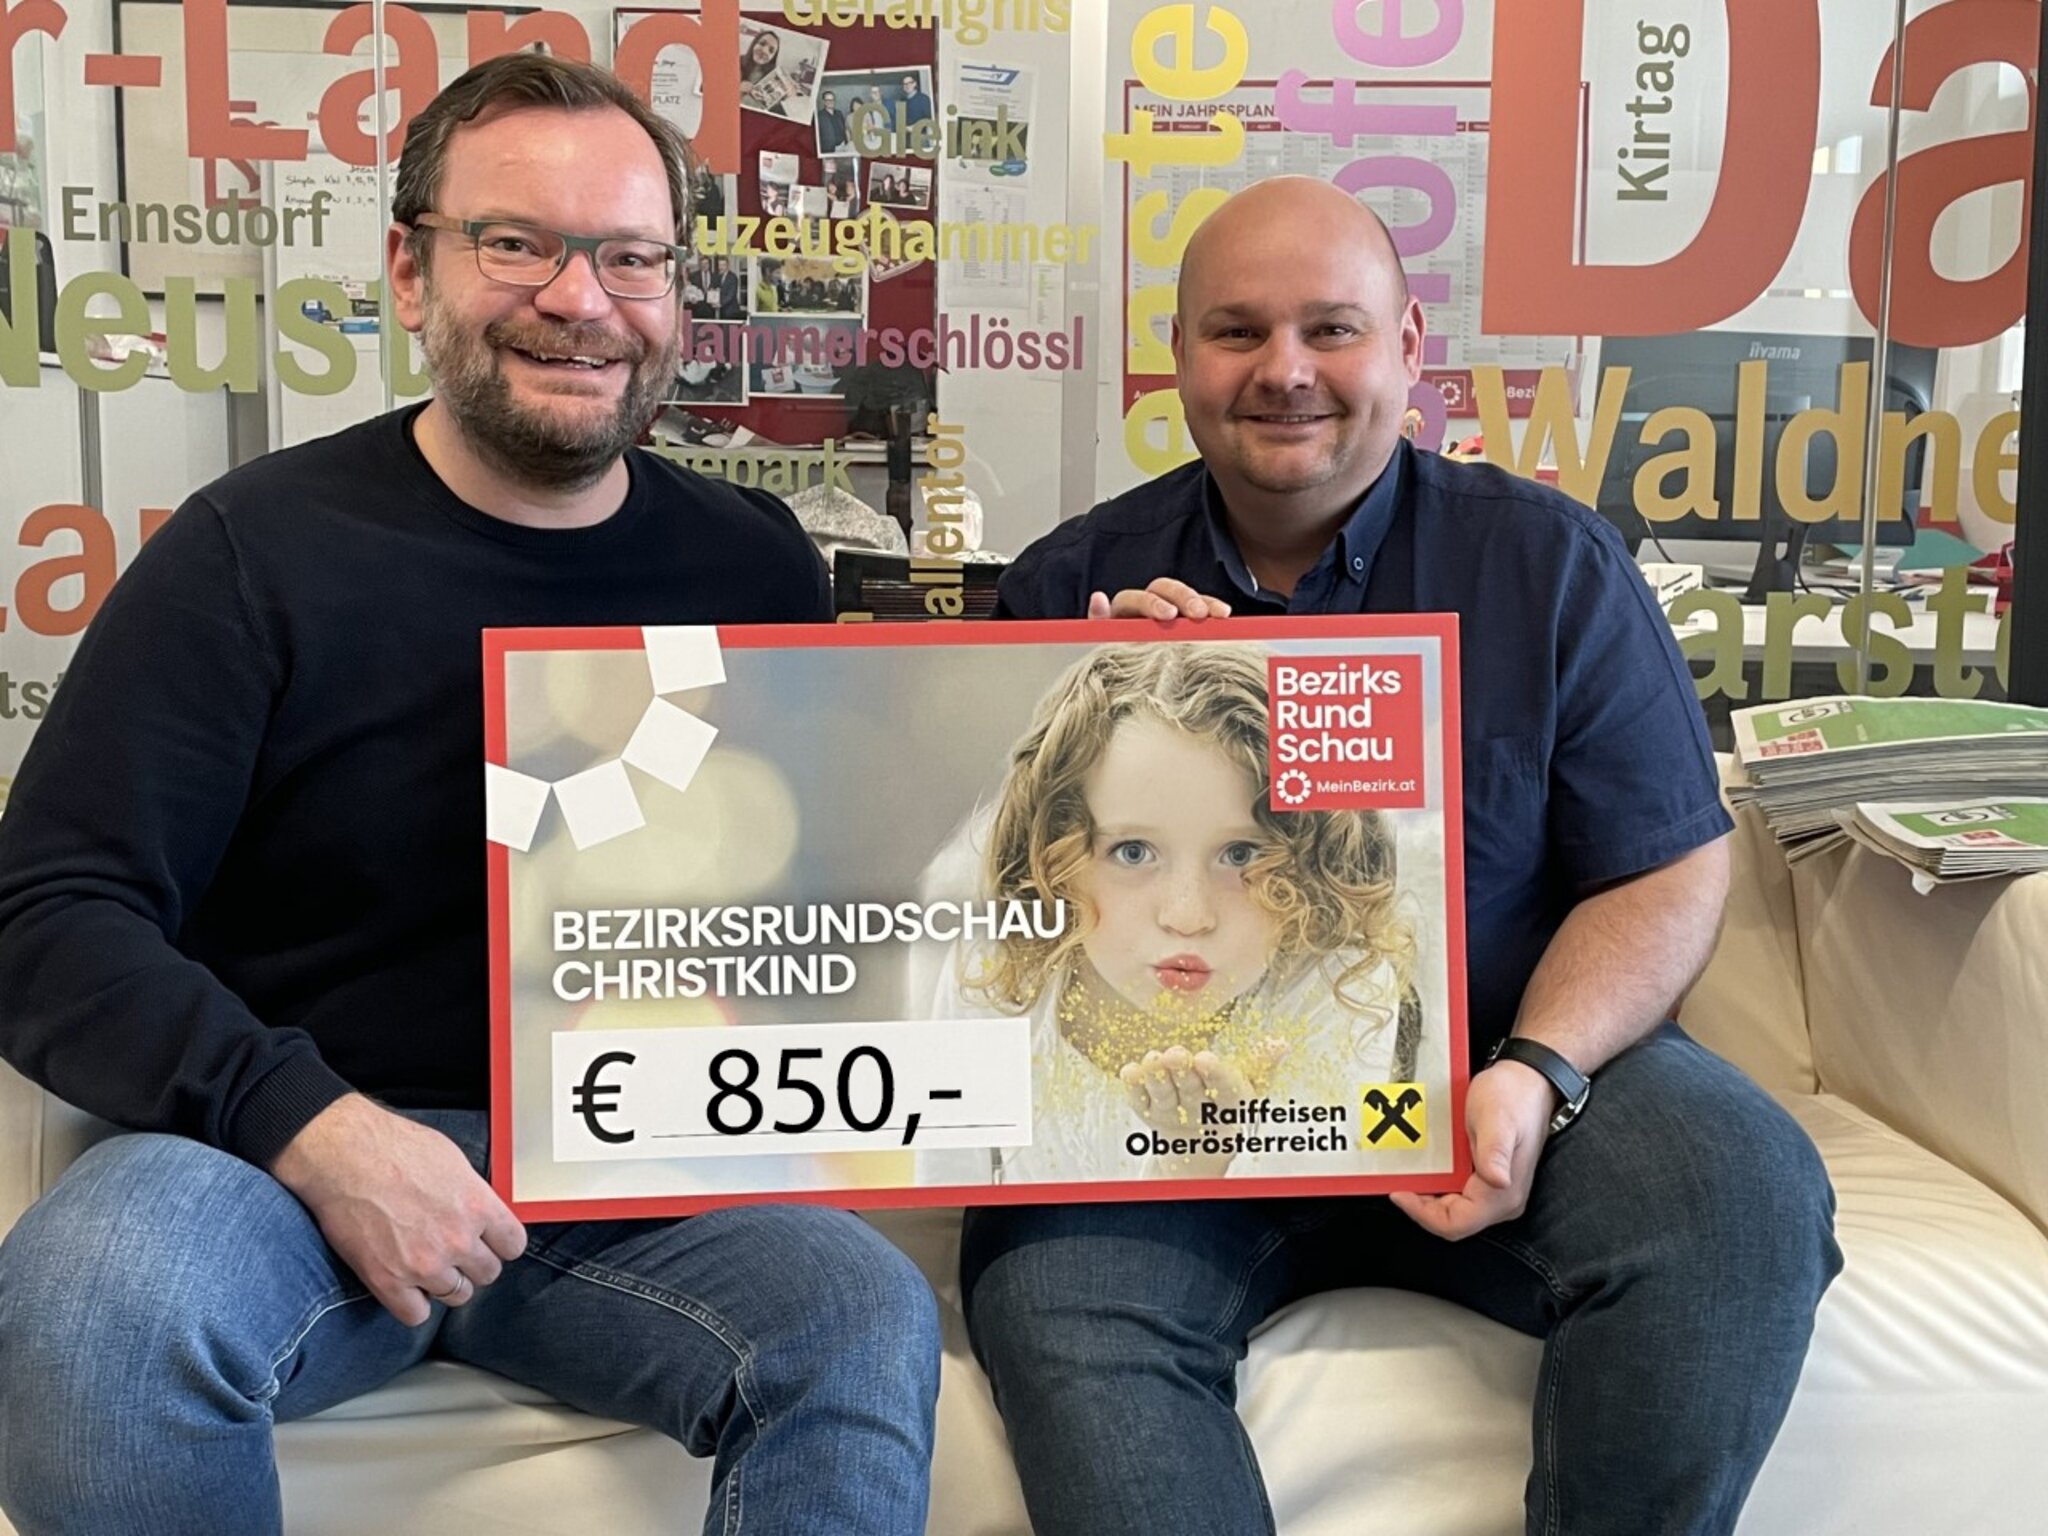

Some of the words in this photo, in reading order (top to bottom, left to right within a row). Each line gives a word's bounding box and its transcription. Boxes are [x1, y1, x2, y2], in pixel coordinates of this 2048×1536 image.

[852, 101, 1028, 160] Gleink
[1616, 20, 1690, 201] Kirtag
[61, 186, 332, 247] Ennsdorf
[1276, 663, 1402, 695] Bezirks
[1276, 698, 1372, 729] Rund
[1277, 731, 1394, 763] Schau
[1316, 778, 1416, 794] MeinBezirk.at
[552, 900, 1066, 952] BEZIRKSRUNDSCHAU
[552, 953, 857, 1001] CHRISTKIND
[571, 1050, 637, 1144] €
[705, 1045, 963, 1146] 850,-
[1200, 1099, 1347, 1125] Raiffeisen
[1125, 1126, 1348, 1157] Oberösterreich
